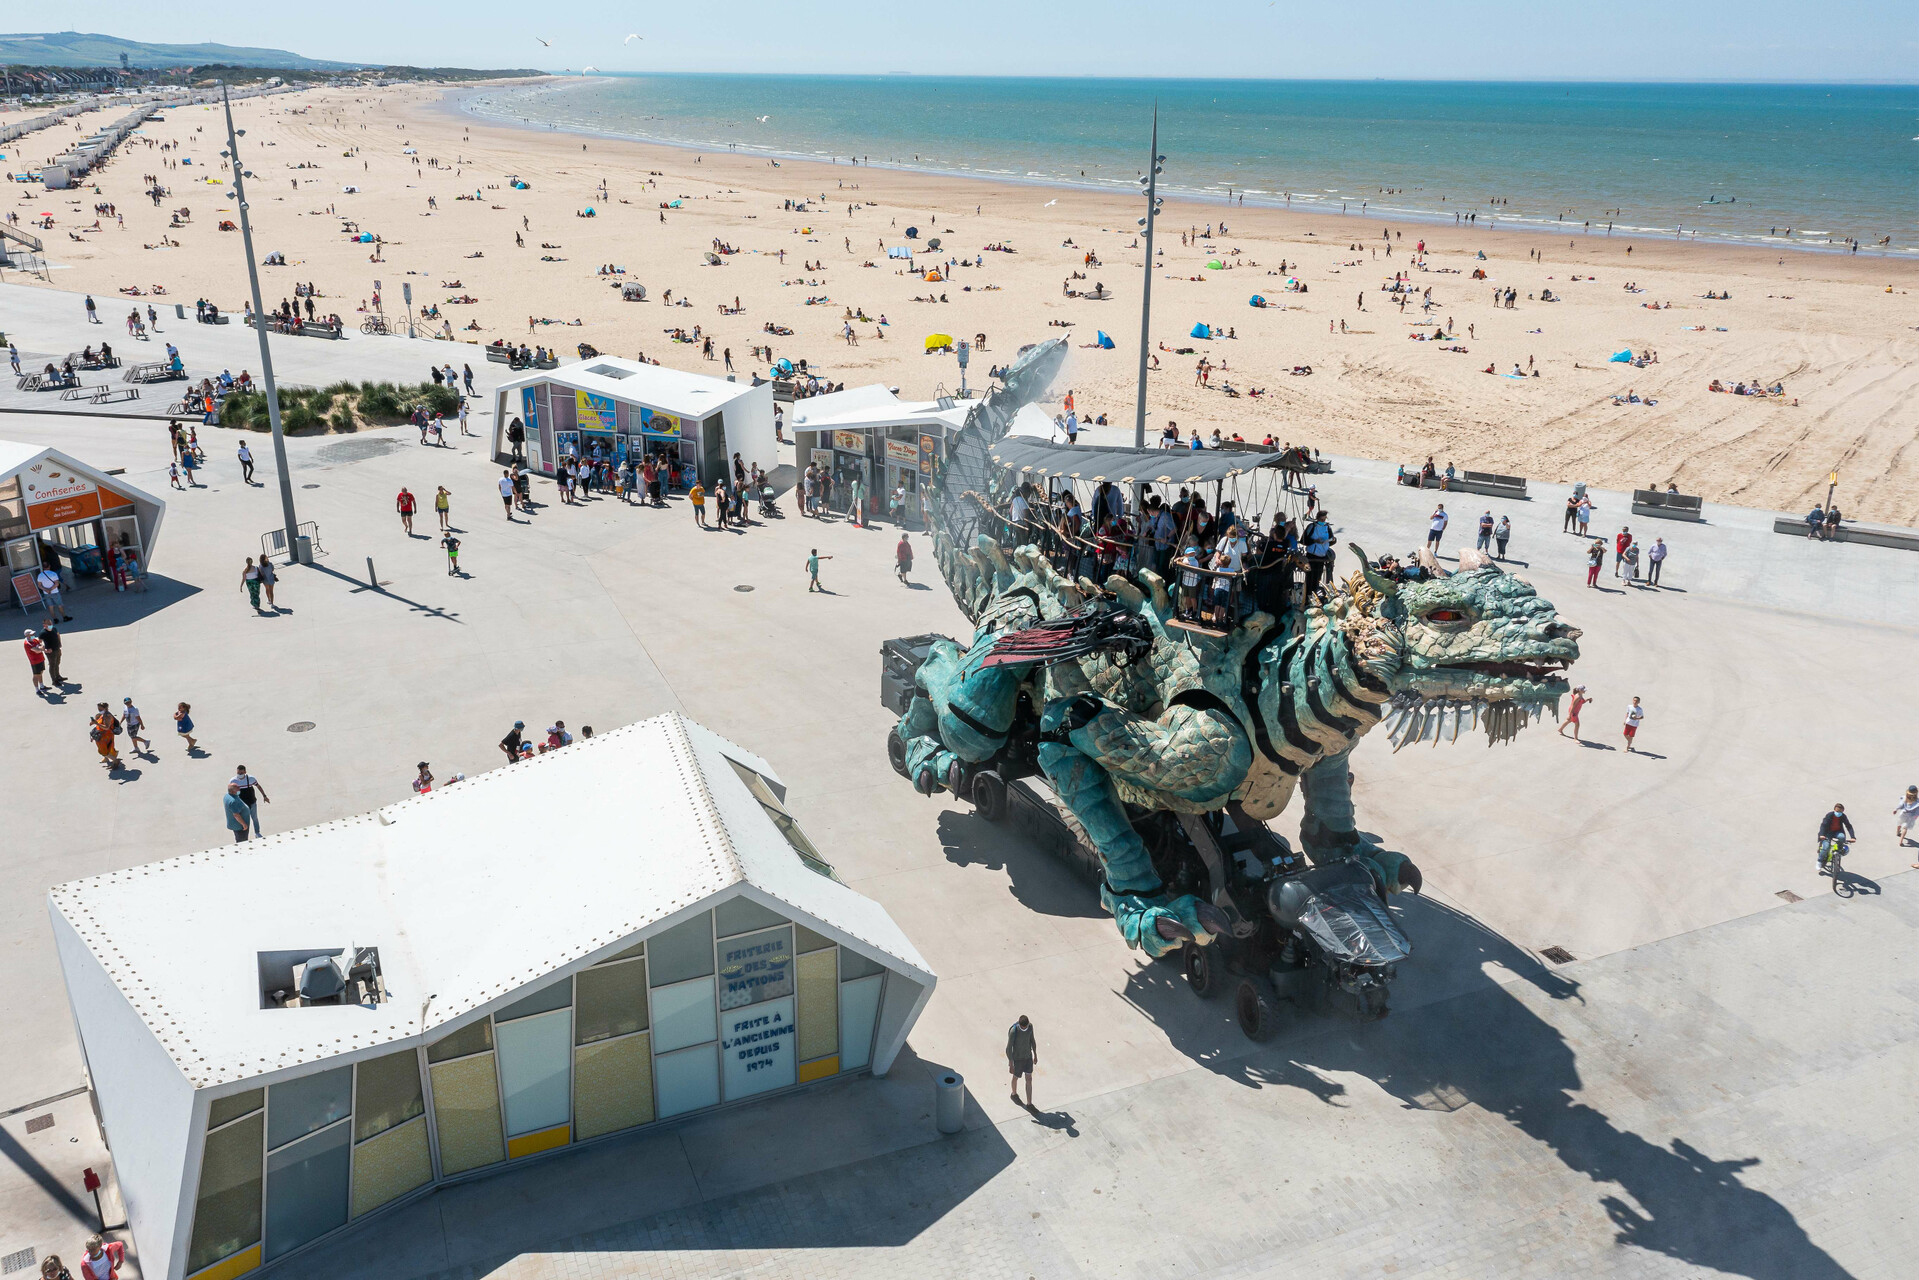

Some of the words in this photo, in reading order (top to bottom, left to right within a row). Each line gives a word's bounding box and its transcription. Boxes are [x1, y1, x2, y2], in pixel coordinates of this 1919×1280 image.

[578, 413, 597, 421] Glaces
[35, 483, 86, 500] Confiseries
[726, 940, 784, 962] FRITERIE
[744, 959, 767, 973] DES
[728, 971, 785, 993] NATIONS
[734, 1015, 770, 1033] FRITE
[722, 1024, 795, 1050] L'ANCIENNE
[738, 1042, 780, 1060] DEPUIS
[746, 1058, 774, 1073] 1974
